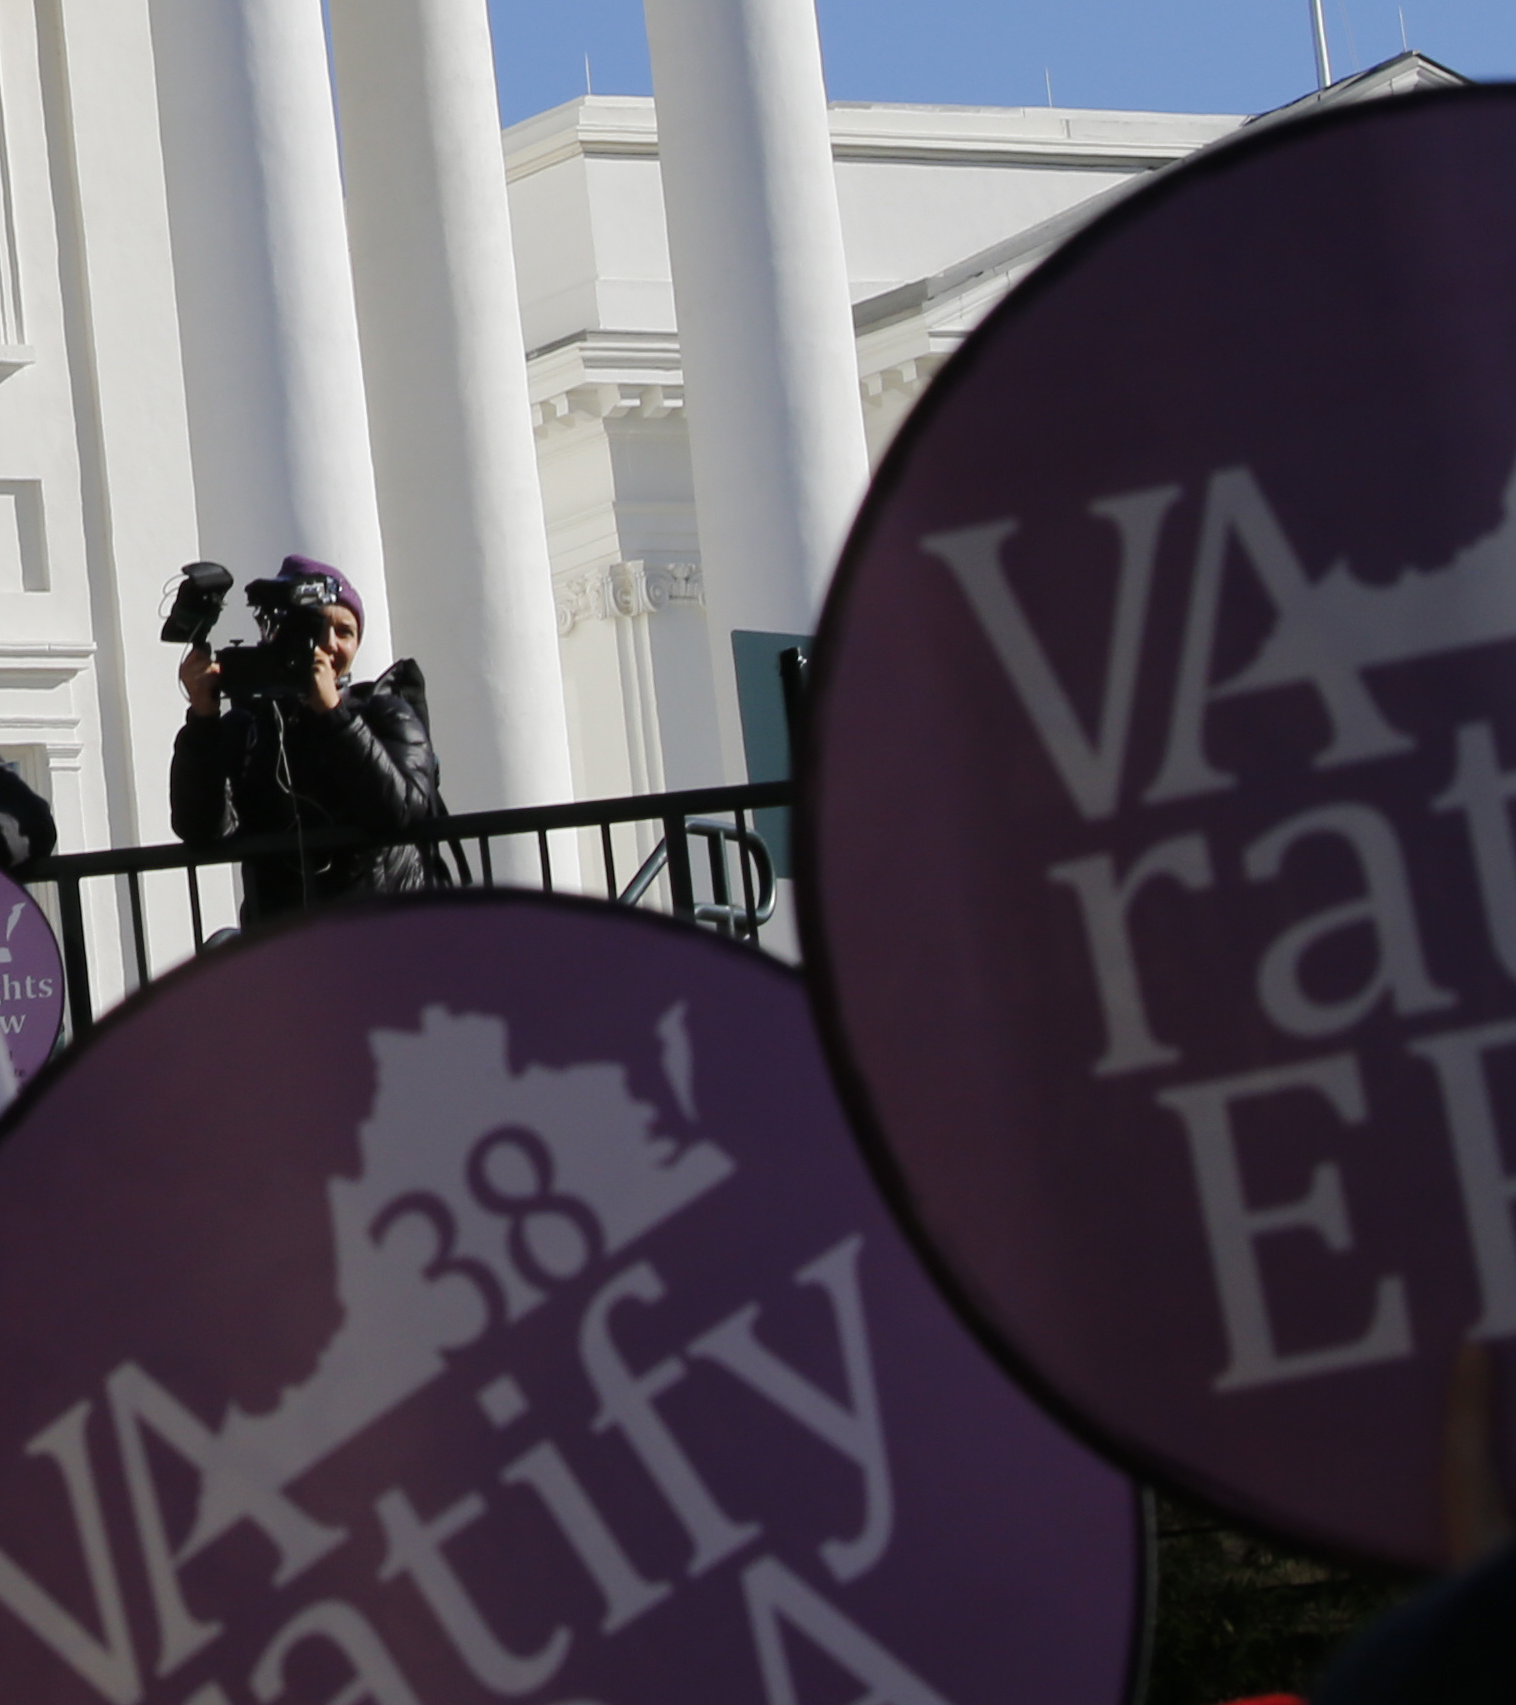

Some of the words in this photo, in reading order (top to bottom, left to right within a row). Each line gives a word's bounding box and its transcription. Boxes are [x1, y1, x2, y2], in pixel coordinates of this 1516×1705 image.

[920, 465, 1415, 821] VA
[1046, 720, 1516, 1077] rat
[368, 1124, 607, 1355] 38
